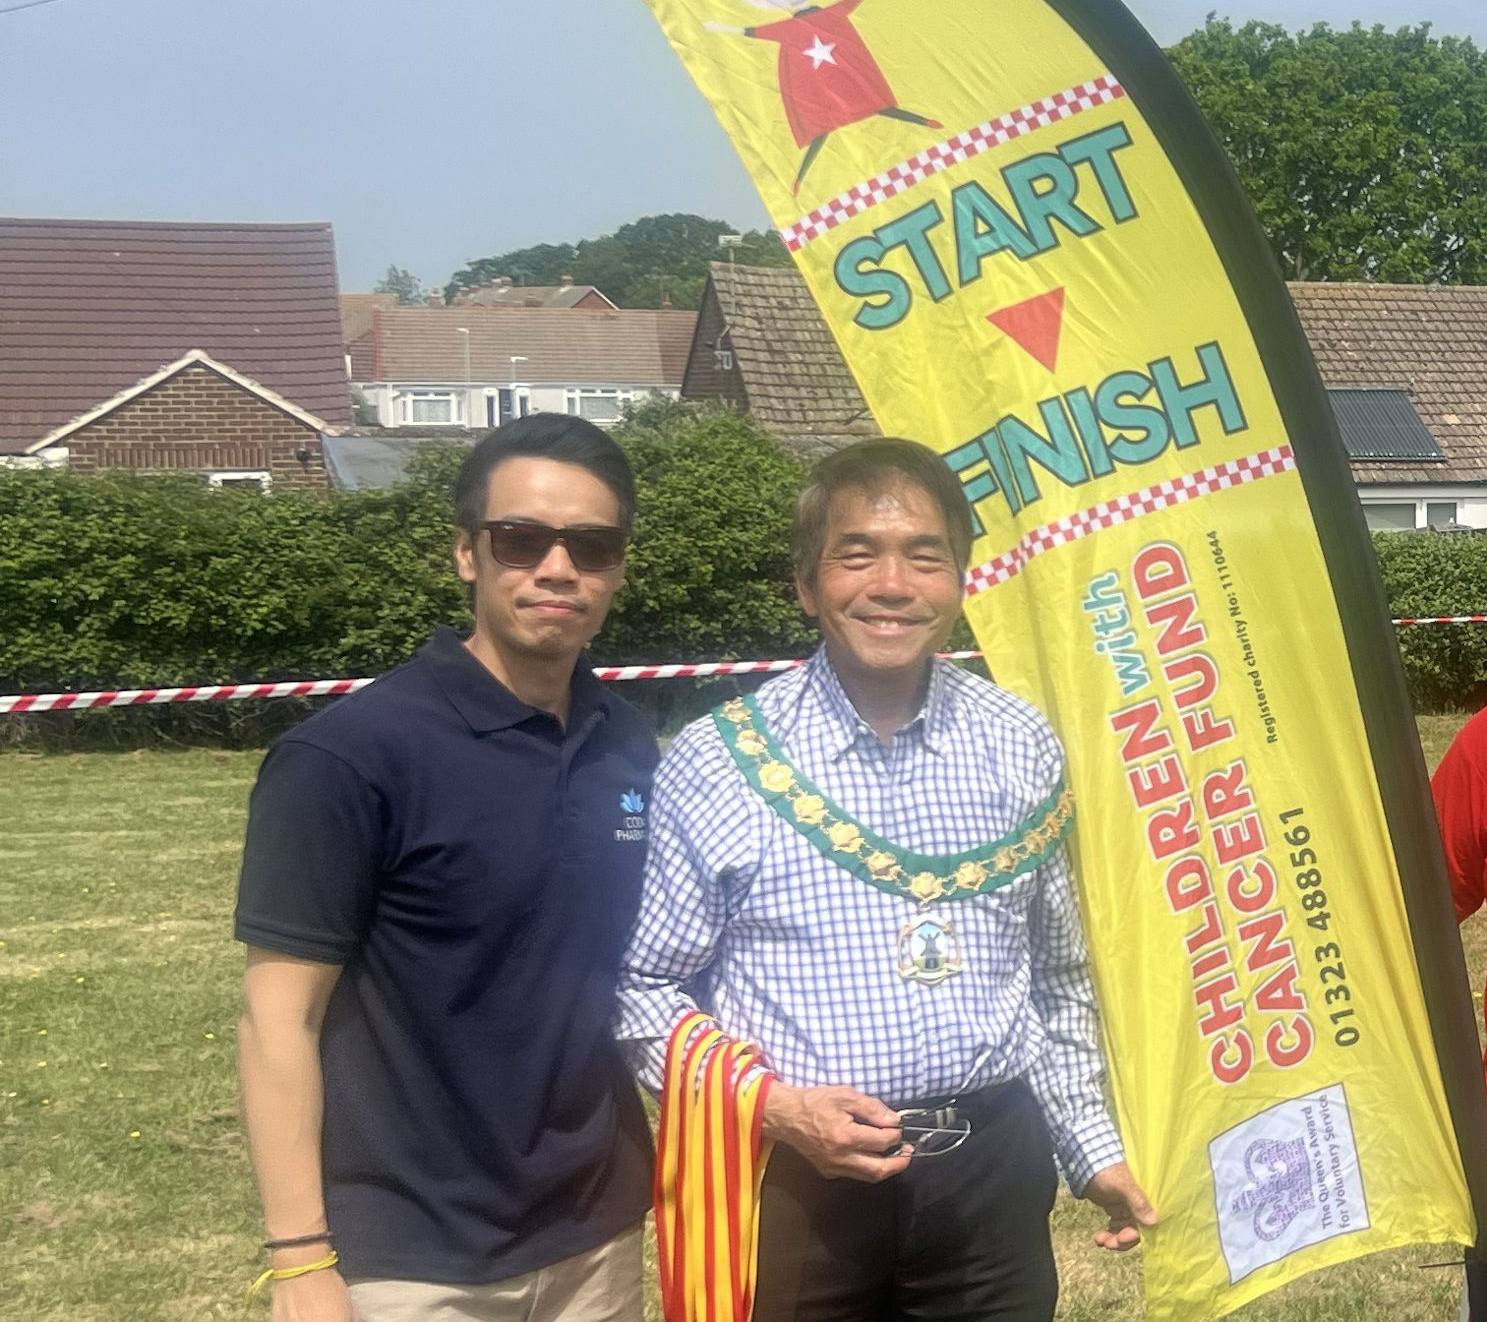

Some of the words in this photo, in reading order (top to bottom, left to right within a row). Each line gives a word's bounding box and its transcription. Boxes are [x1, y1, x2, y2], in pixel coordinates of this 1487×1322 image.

[833, 121, 1138, 331] START
[940, 340, 1249, 540] FINISH
[1207, 530, 1233, 590] 1110644
[1083, 571, 1151, 696] with
[1227, 592, 1242, 617] No:
[1131, 540, 1235, 753] FUND
[1235, 619, 1257, 667] charity
[1248, 670, 1279, 744] Registered
[1111, 700, 1252, 1084] CHILDREN
[1278, 806, 1332, 930] 488561
[1202, 759, 1315, 1071] CANCER
[1313, 938, 1360, 1048] 01323
[1301, 1106, 1318, 1148] Award
[1318, 1094, 1336, 1142] Service
[1329, 1143, 1347, 1208] Voluntary
[1321, 1204, 1333, 1229] The
[1339, 1208, 1351, 1228] for
